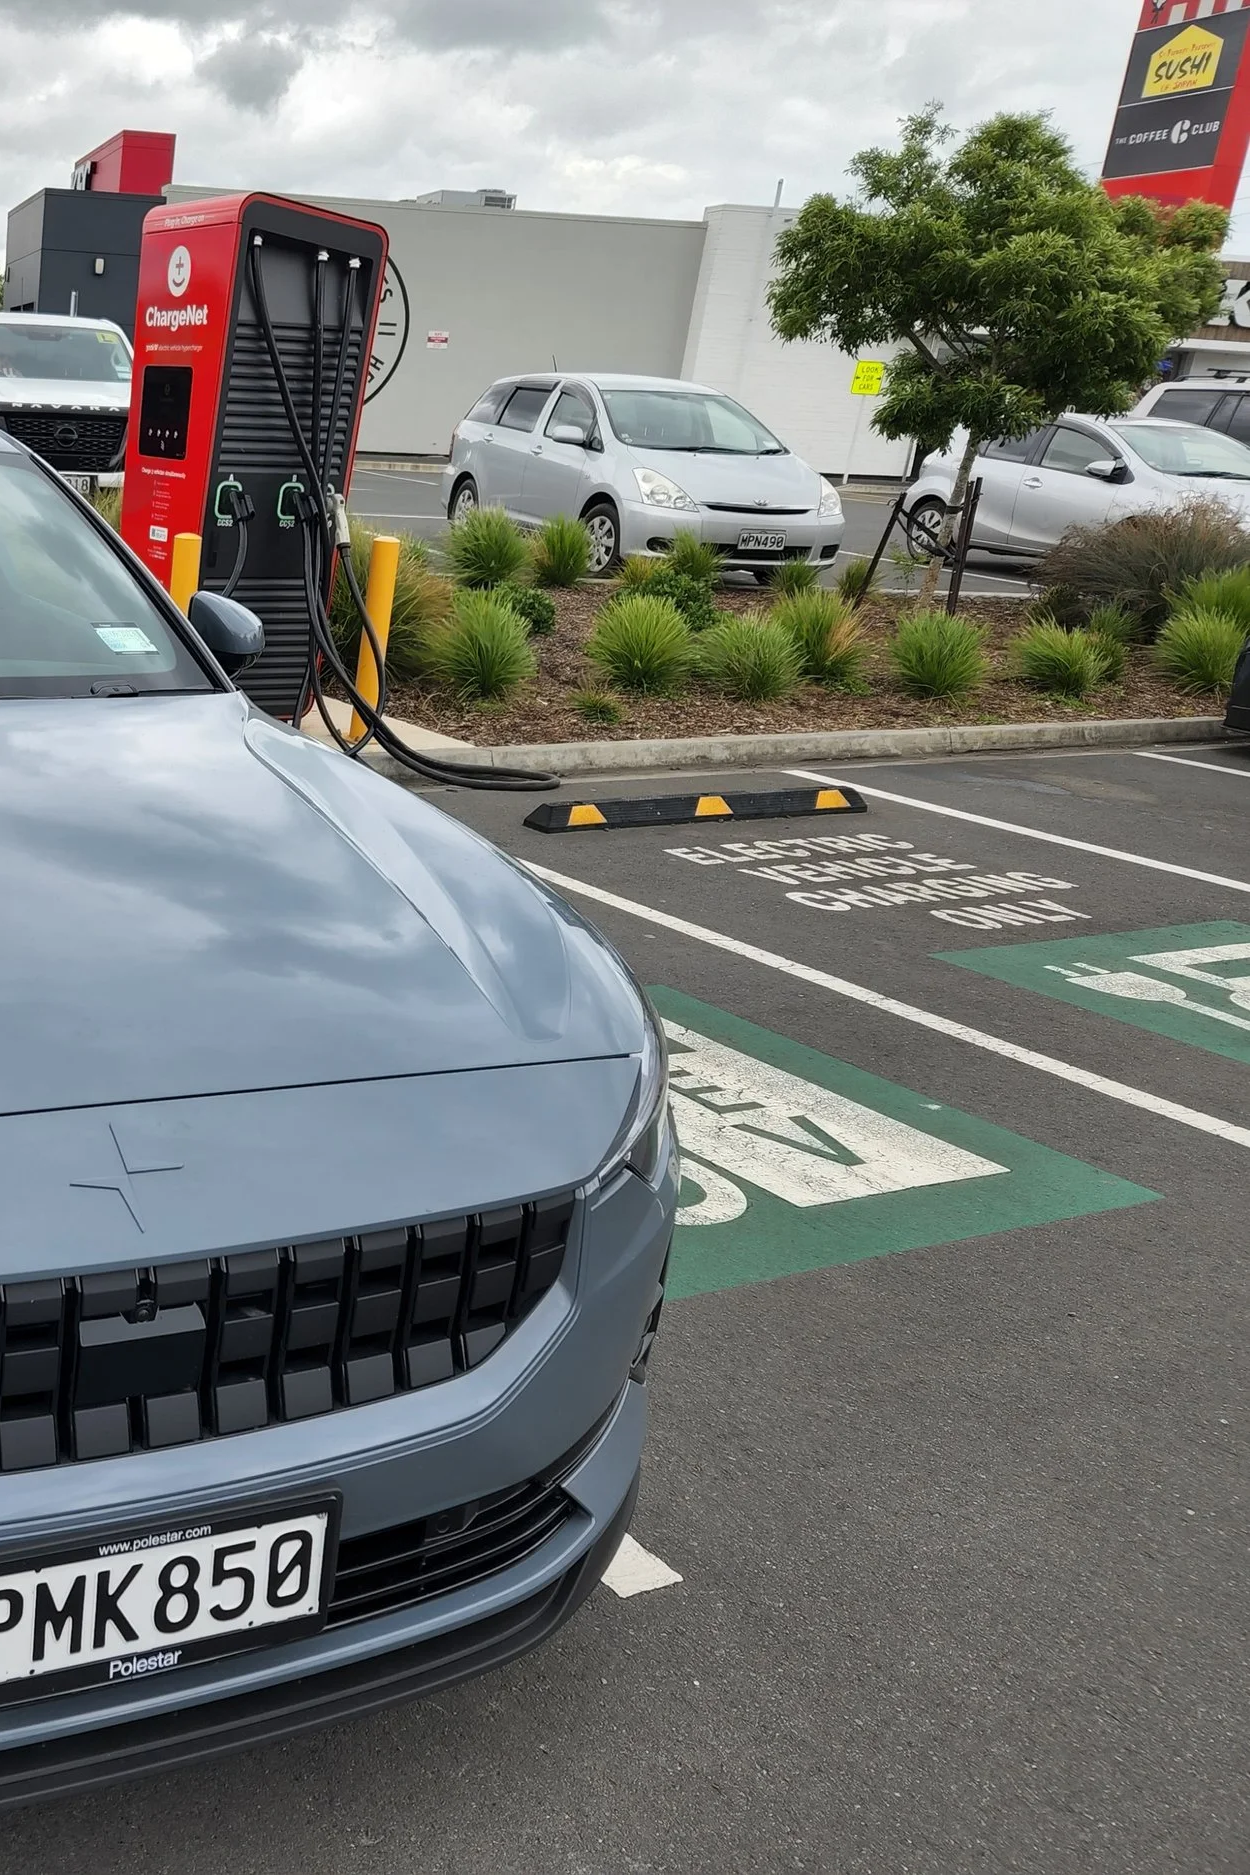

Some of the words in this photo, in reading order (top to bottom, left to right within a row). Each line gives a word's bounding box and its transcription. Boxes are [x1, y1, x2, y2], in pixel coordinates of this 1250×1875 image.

[1153, 52, 1212, 83] SUSHI
[1129, 129, 1169, 145] COFFEE
[1192, 121, 1220, 135] CLUB
[145, 304, 208, 332] ChargeNet
[12, 402, 120, 412] NAVARA
[217, 519, 233, 527] CCS2
[663, 833, 915, 866] ELECTRIC
[737, 853, 977, 885] VEHICLE
[785, 871, 1079, 911] CHARGING
[930, 899, 1092, 930] ONLY
[99, 1524, 212, 1556] www.polestar.com
[109, 1650, 182, 1679] Polestar
